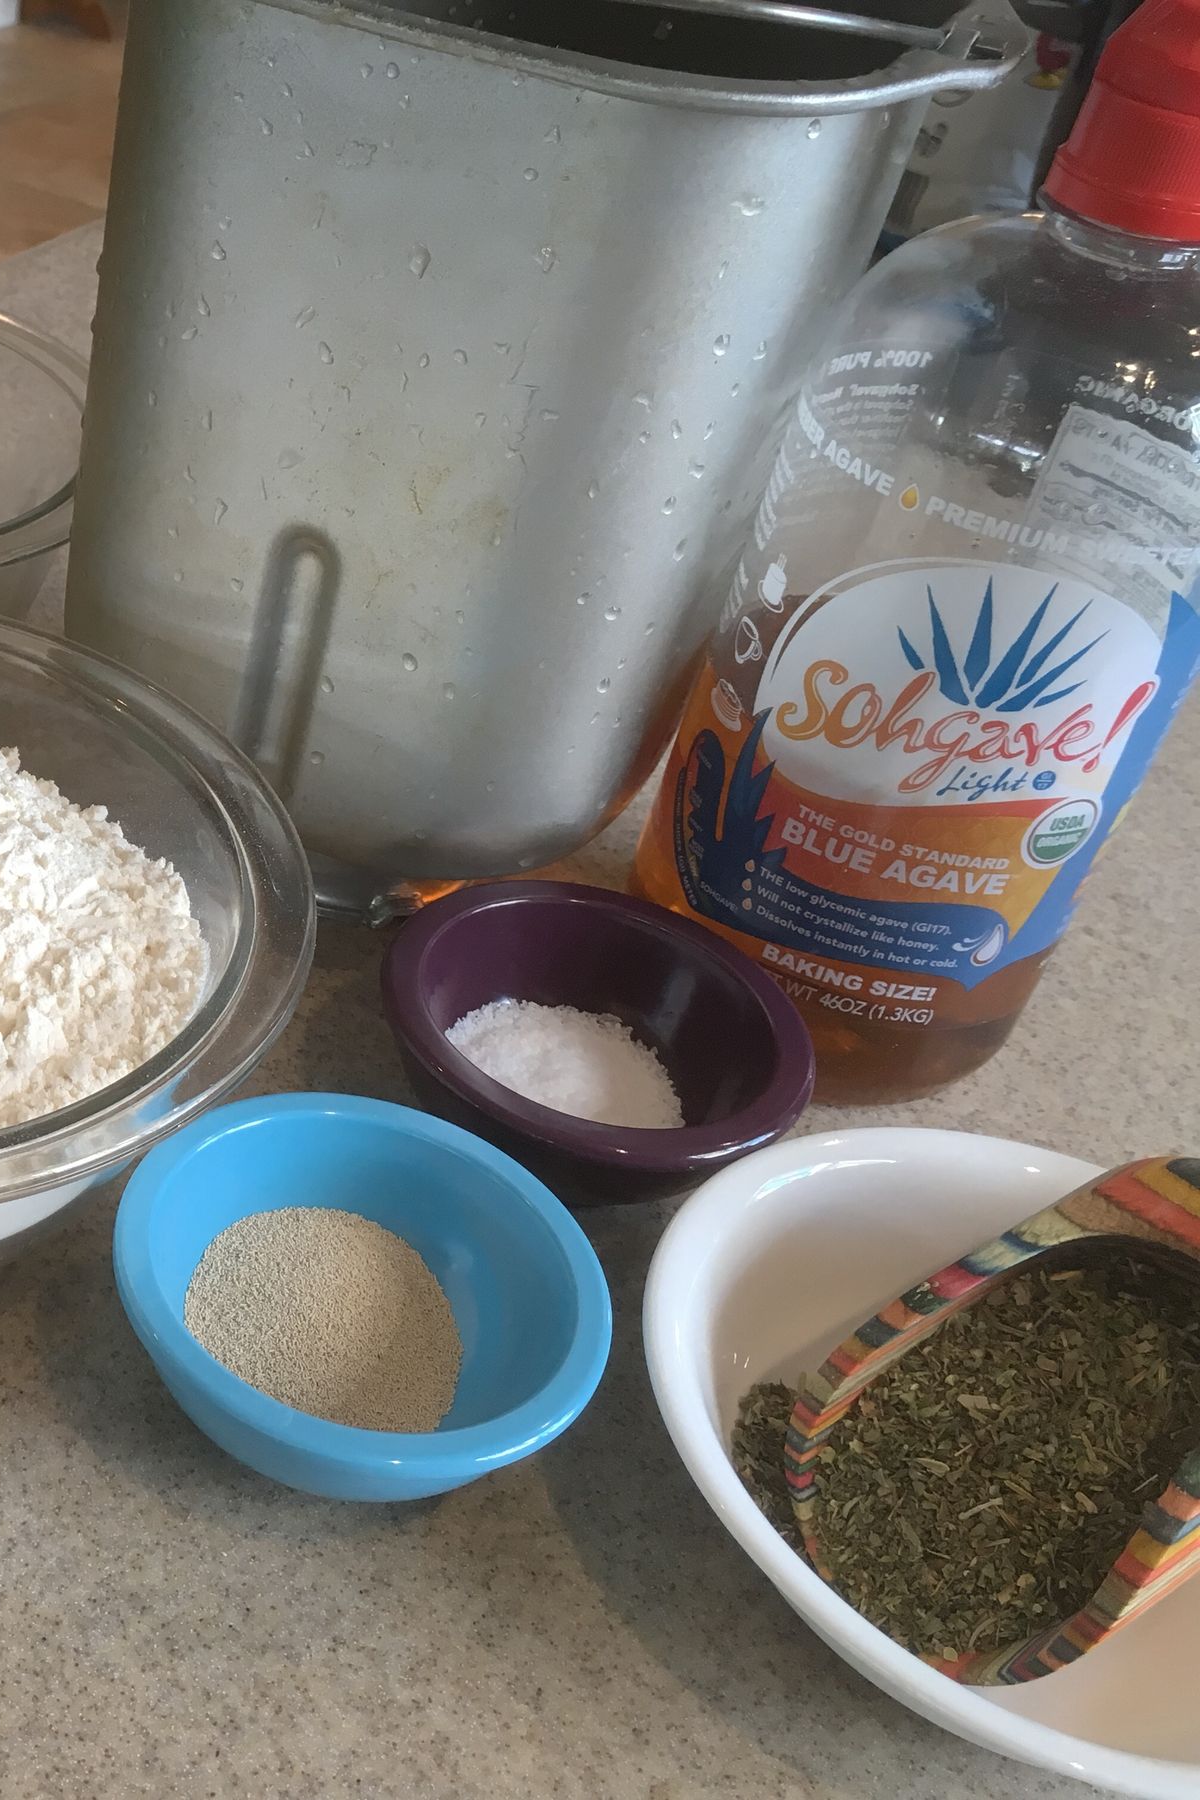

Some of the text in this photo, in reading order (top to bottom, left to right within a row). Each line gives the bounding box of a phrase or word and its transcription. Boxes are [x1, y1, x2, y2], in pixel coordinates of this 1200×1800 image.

[823, 440, 896, 496] AGAVE
[924, 495, 1072, 554] PREMIUM
[775, 660, 1158, 793] Sohgave!
[937, 766, 1028, 802] Light
[781, 816, 1010, 895] BLUE AGAVE
[798, 803, 1010, 871] THE GOLD STANDARD
[1049, 814, 1086, 832] USDA
[757, 884, 940, 954] Will not crystallize like honey.
[759, 866, 785, 888] THE
[785, 879, 809, 899] low
[808, 890, 867, 922] glycemic
[868, 914, 909, 934] agave
[756, 904, 959, 969] Dissolves instantly in hot or cold.
[761, 943, 938, 1002] BAKING SIZE!
[785, 978, 819, 1001] WT
[868, 1003, 934, 1026] (1.3KG)
